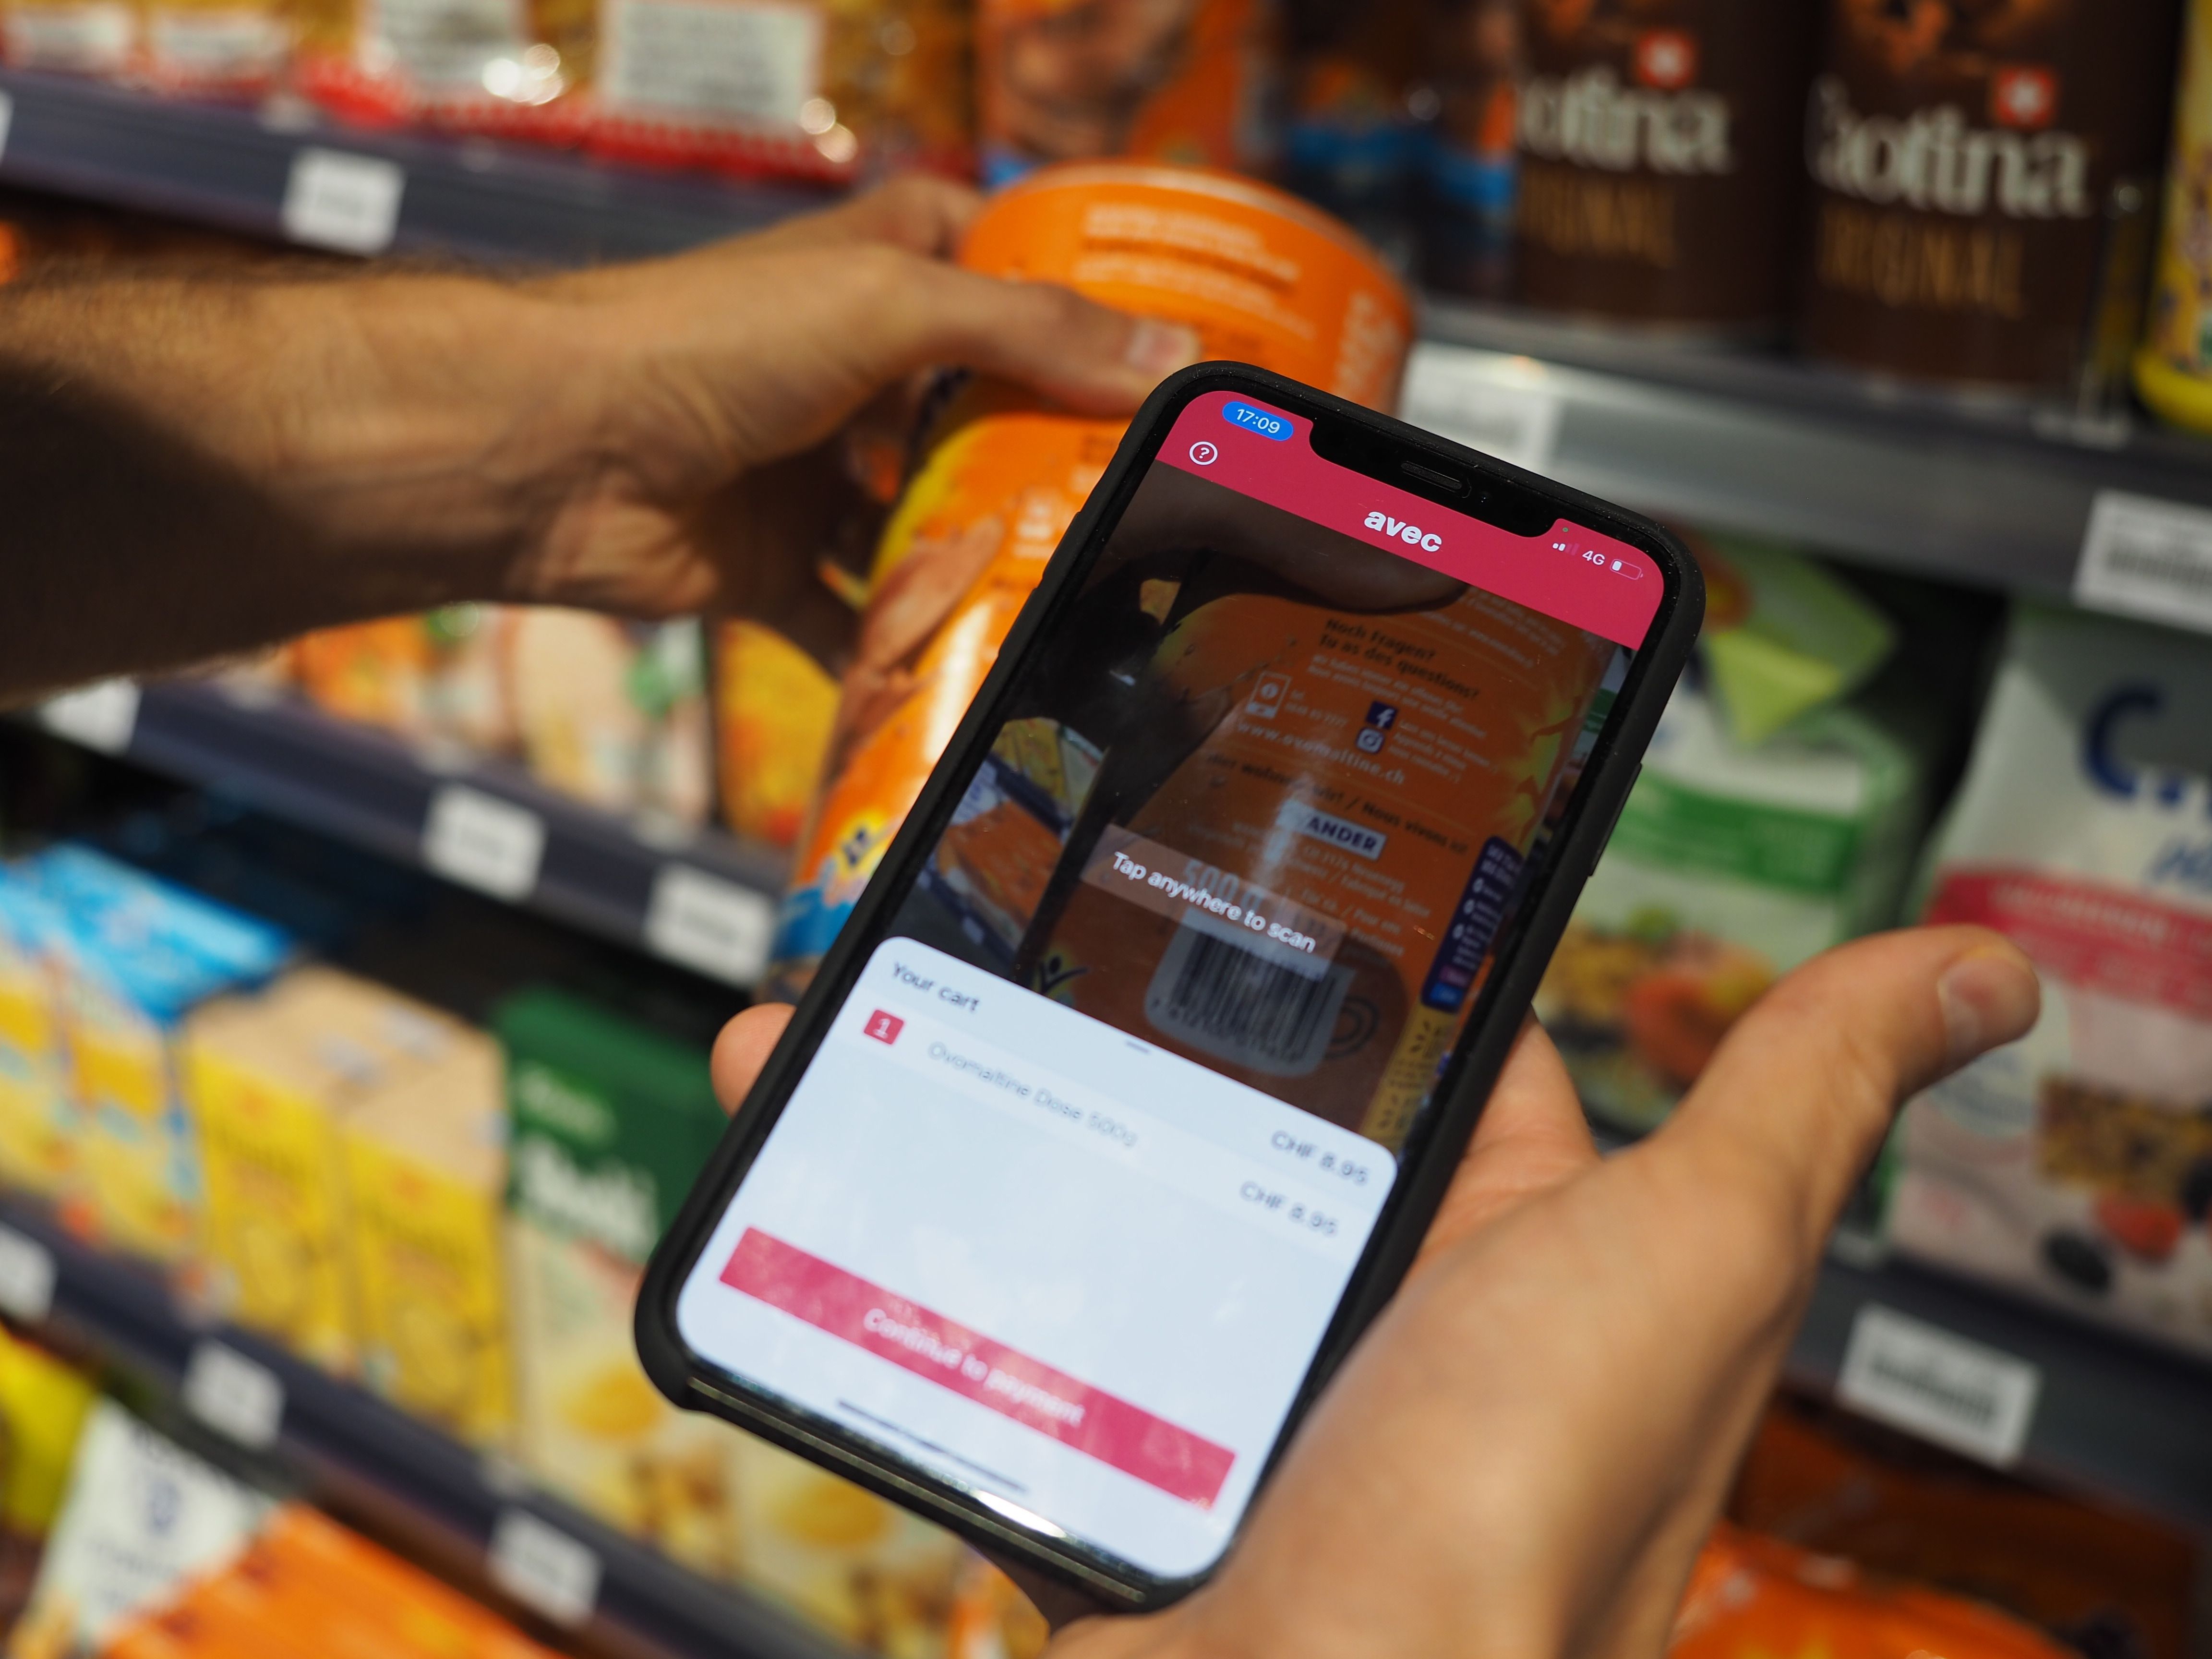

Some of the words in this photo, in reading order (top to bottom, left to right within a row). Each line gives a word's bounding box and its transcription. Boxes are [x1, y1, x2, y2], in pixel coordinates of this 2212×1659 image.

[1237, 409, 1280, 433] 17:09
[1364, 511, 1442, 552] avec
[1582, 551, 1605, 565] 4G
[1298, 812, 1378, 853] ANDER
[1113, 852, 1146, 880] Tap
[1148, 872, 1242, 921] anywhere
[1244, 909, 1266, 931] to
[1267, 923, 1316, 953] scan
[893, 962, 935, 992] Your
[938, 985, 980, 1013] cart
[872, 1017, 891, 1039] 1
[927, 1041, 1032, 1099] Ovomaltine
[1034, 1088, 1083, 1121] Dose
[1088, 1110, 1138, 1148] 500g
[1271, 1130, 1316, 1157] CHF
[1240, 1181, 1286, 1210] CHF
[865, 1308, 962, 1369] Continue
[962, 1354, 988, 1381] to
[984, 1369, 1086, 1428] payment
